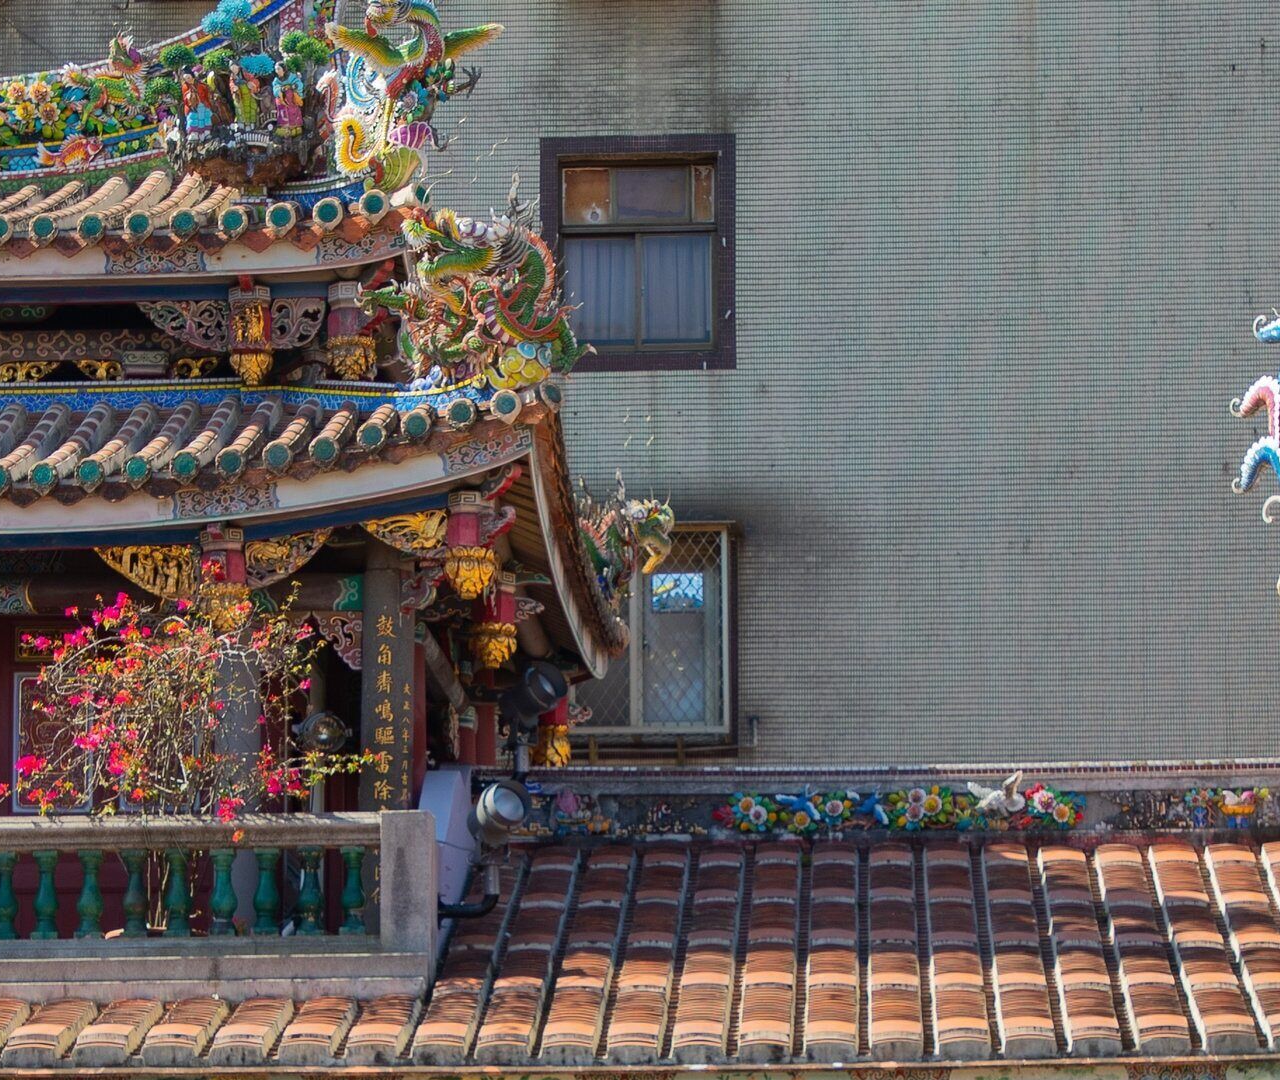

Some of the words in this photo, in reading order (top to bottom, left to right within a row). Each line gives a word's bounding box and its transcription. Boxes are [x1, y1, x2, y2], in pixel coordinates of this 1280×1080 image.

[374, 614, 397, 812] 鼓角齊鳴驅雷除
